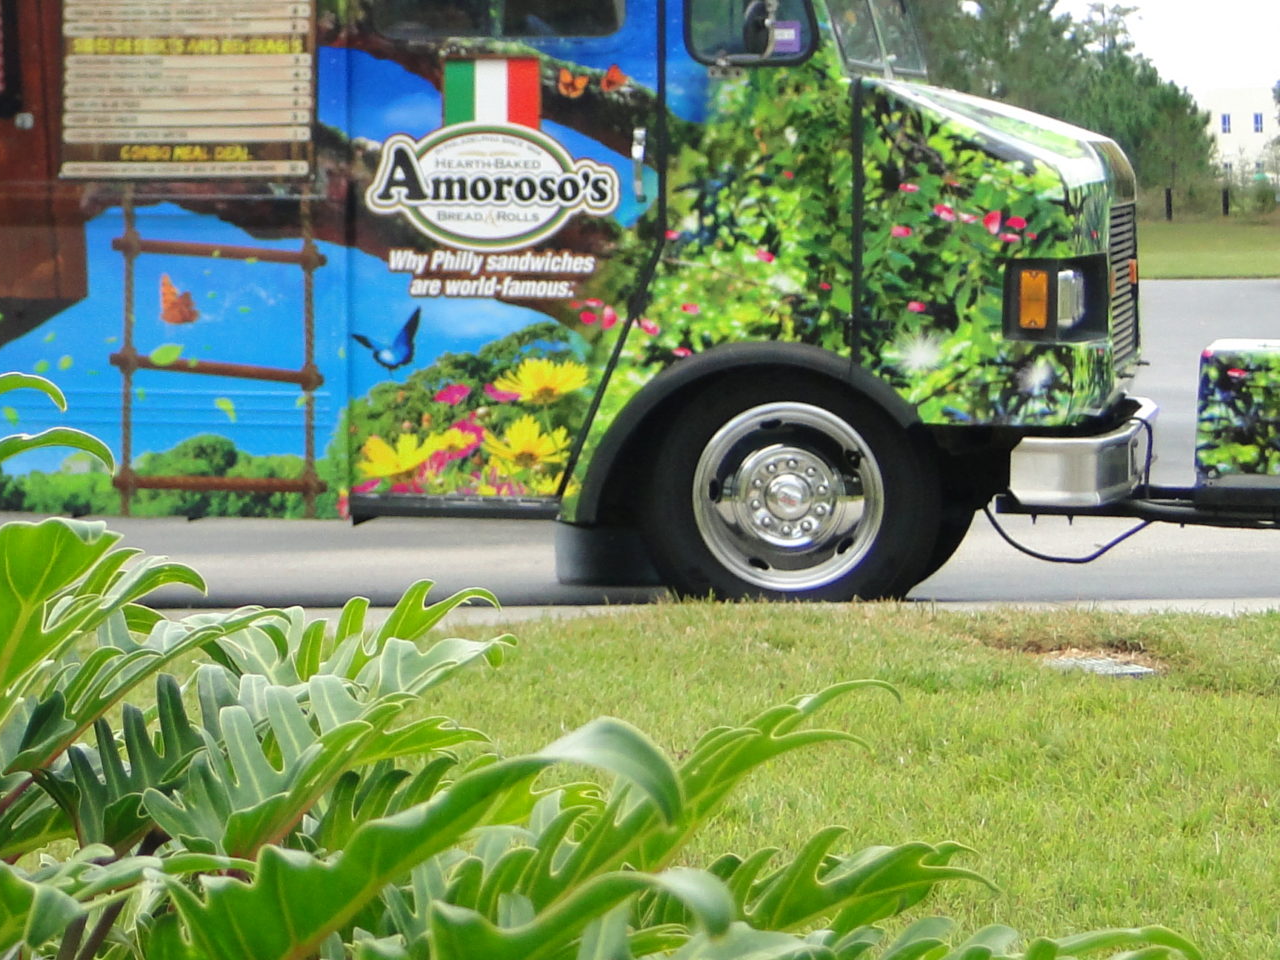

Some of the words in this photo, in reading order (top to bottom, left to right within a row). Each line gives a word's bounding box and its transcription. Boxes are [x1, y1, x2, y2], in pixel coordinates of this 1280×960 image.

[378, 147, 608, 202] Amoroso's
[436, 211, 484, 223] BREAD
[497, 210, 541, 223] ROLLS
[389, 250, 427, 274] Why
[430, 250, 483, 274] Philly
[486, 251, 595, 272] sandwiches
[410, 279, 440, 296] are
